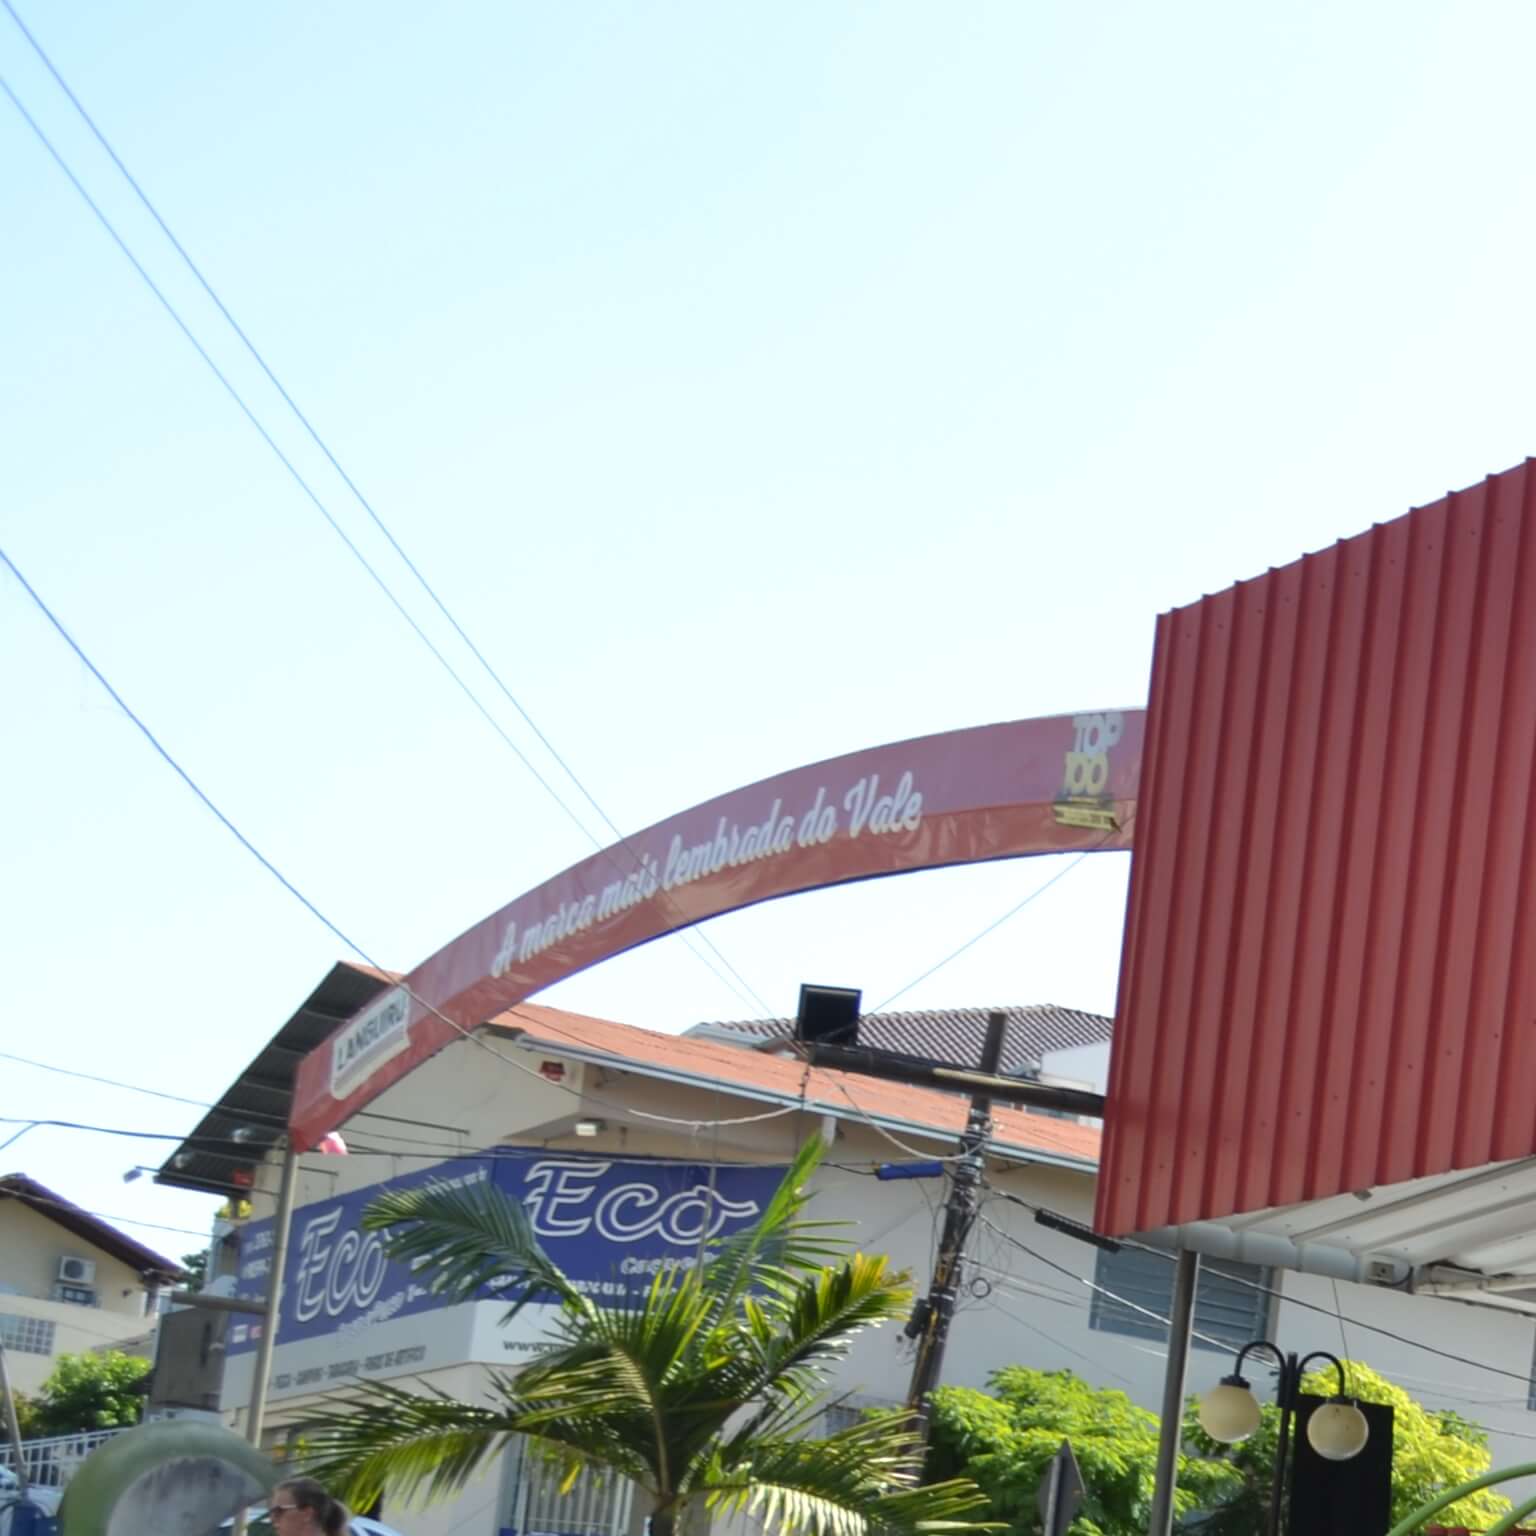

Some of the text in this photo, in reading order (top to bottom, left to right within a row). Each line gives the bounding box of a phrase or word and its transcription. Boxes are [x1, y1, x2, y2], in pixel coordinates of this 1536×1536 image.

[1073, 712, 1125, 757] TOP
[490, 771, 923, 977] A marca mais lembrada do Vale
[523, 1161, 760, 1245] Eco
[295, 1205, 393, 1323] Eco
